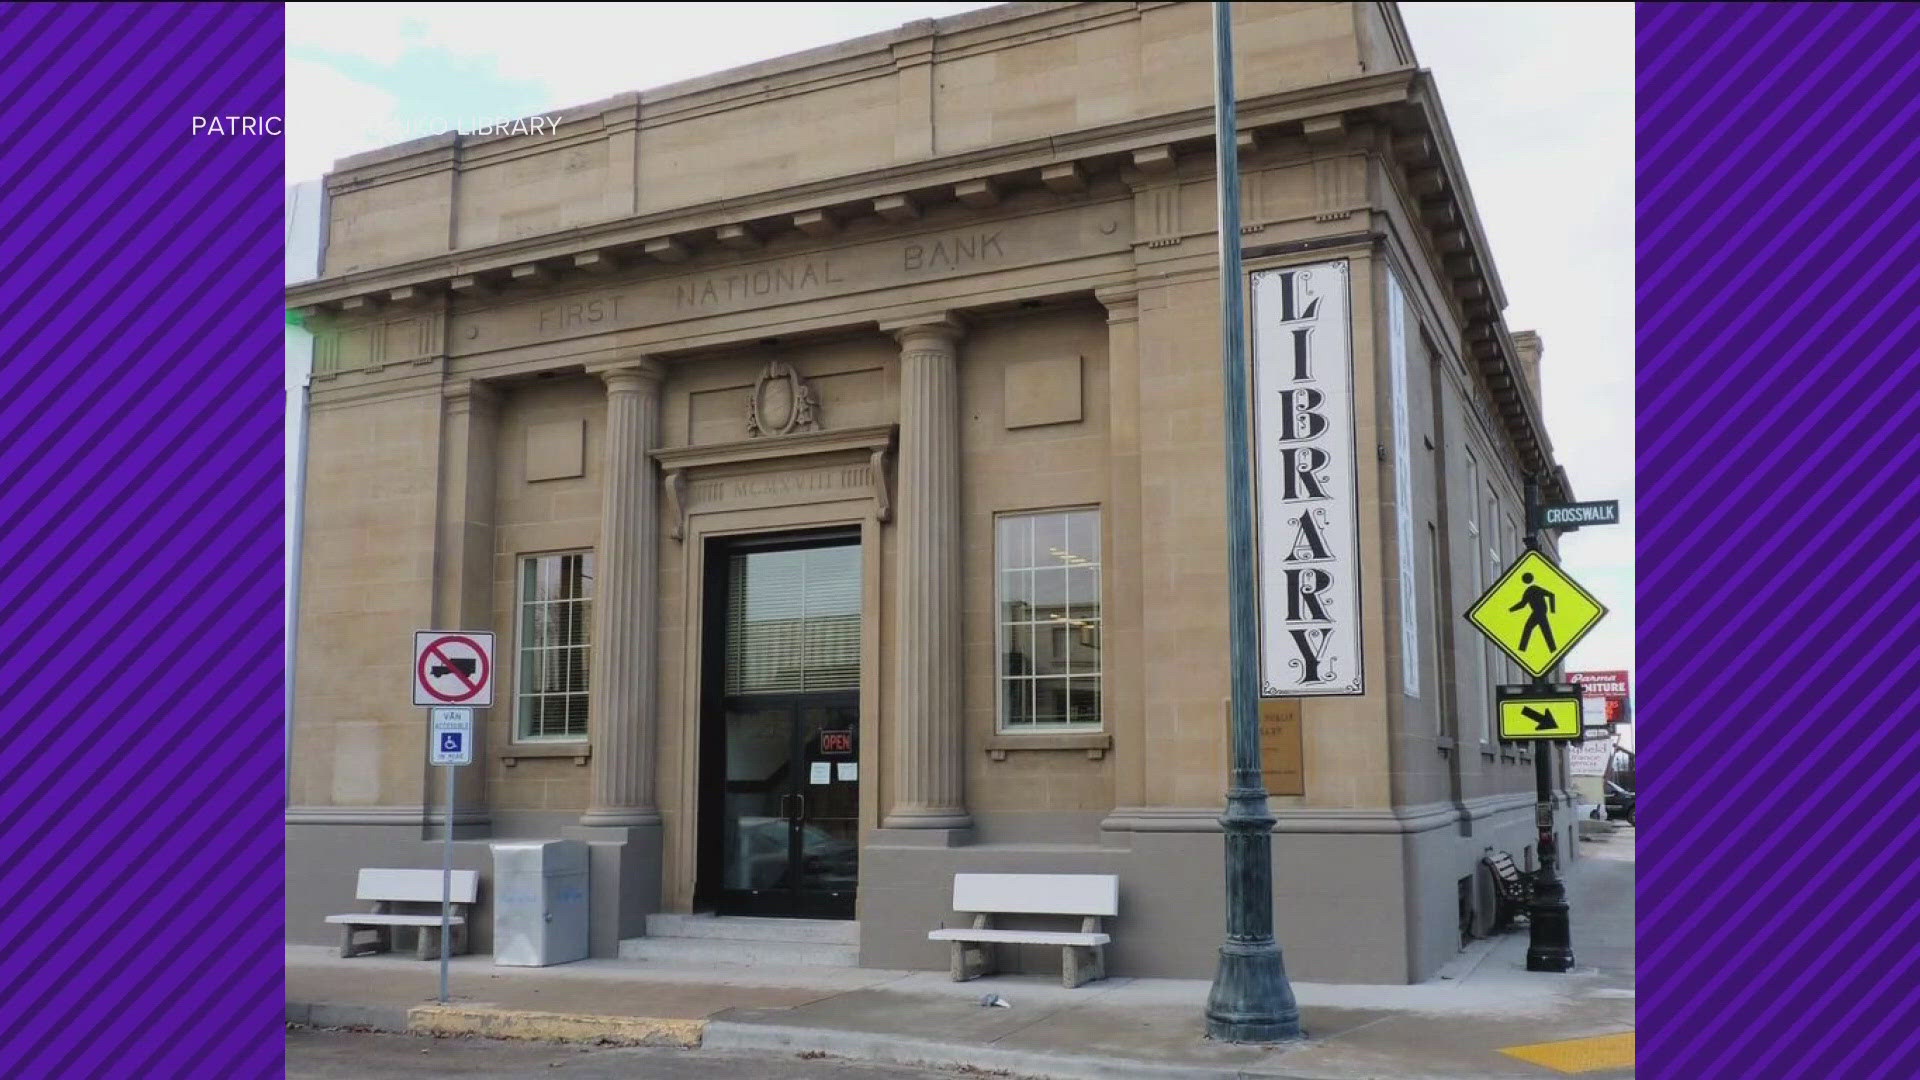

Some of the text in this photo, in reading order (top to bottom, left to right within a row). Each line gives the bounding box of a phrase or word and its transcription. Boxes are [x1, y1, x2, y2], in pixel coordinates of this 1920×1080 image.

[538, 232, 1004, 333] FIRST NATIONAL BANK
[1277, 271, 1337, 687] LIBRARY
[1547, 506, 1614, 522] CROSSWALK
[444, 712, 461, 720] VAN
[824, 735, 849, 750] OPEN
